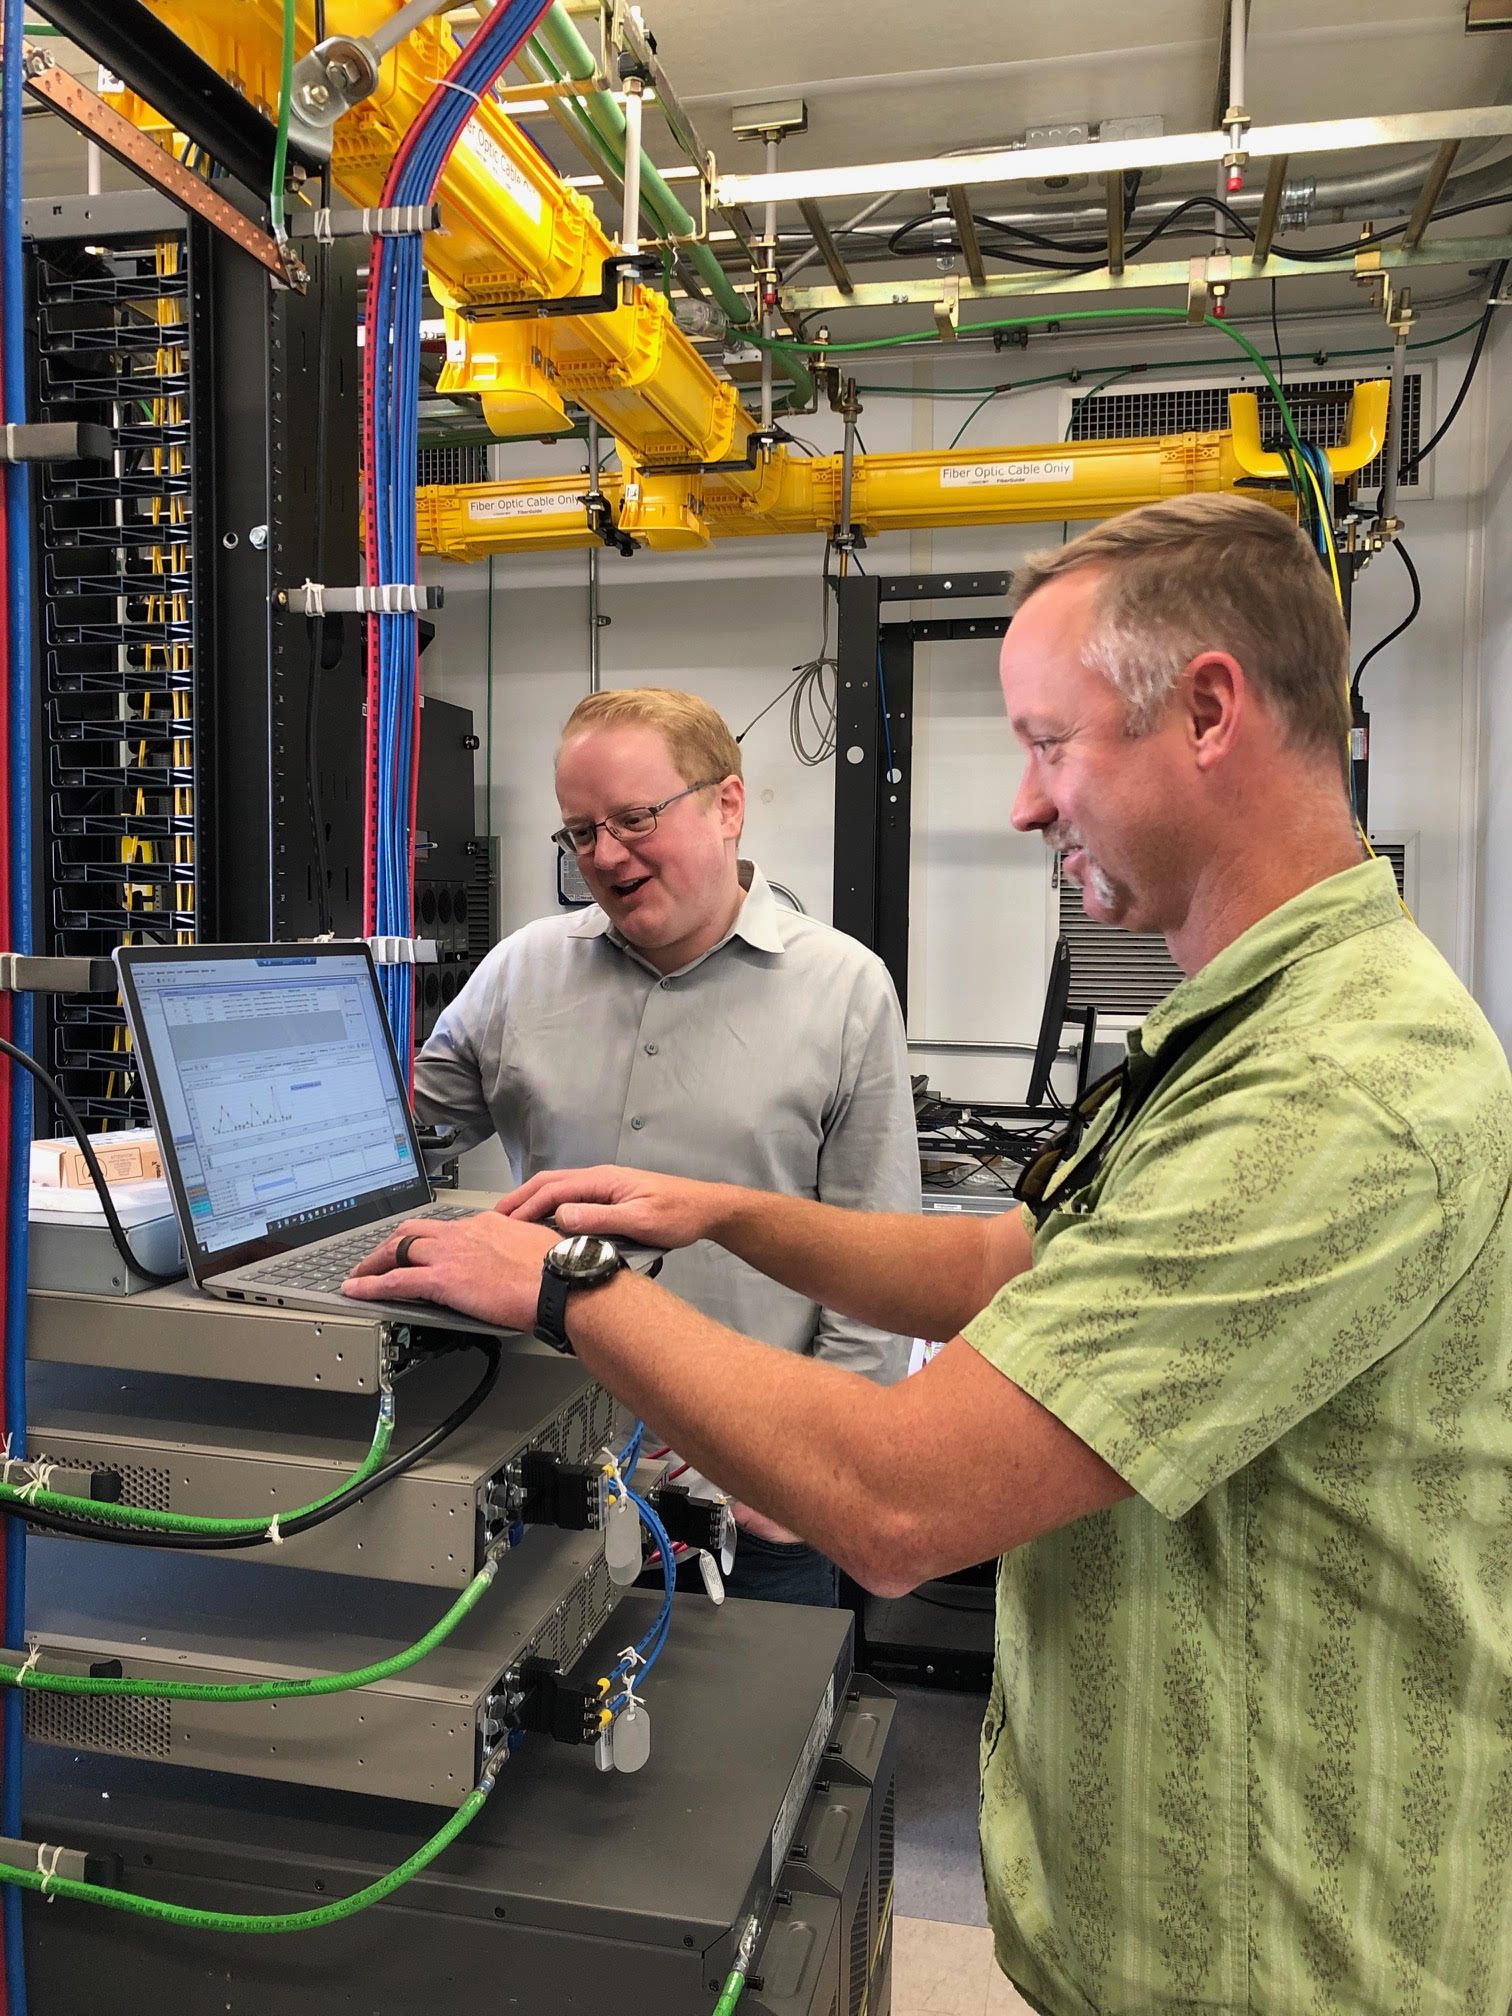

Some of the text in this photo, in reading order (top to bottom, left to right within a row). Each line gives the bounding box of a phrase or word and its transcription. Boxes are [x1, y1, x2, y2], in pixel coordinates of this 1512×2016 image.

[478, 127, 499, 164] Optic
[500, 153, 522, 185] Cable
[943, 462, 1070, 479] Fiber Optic Cable Only
[470, 494, 580, 511] Fiber Optic Cable Only
